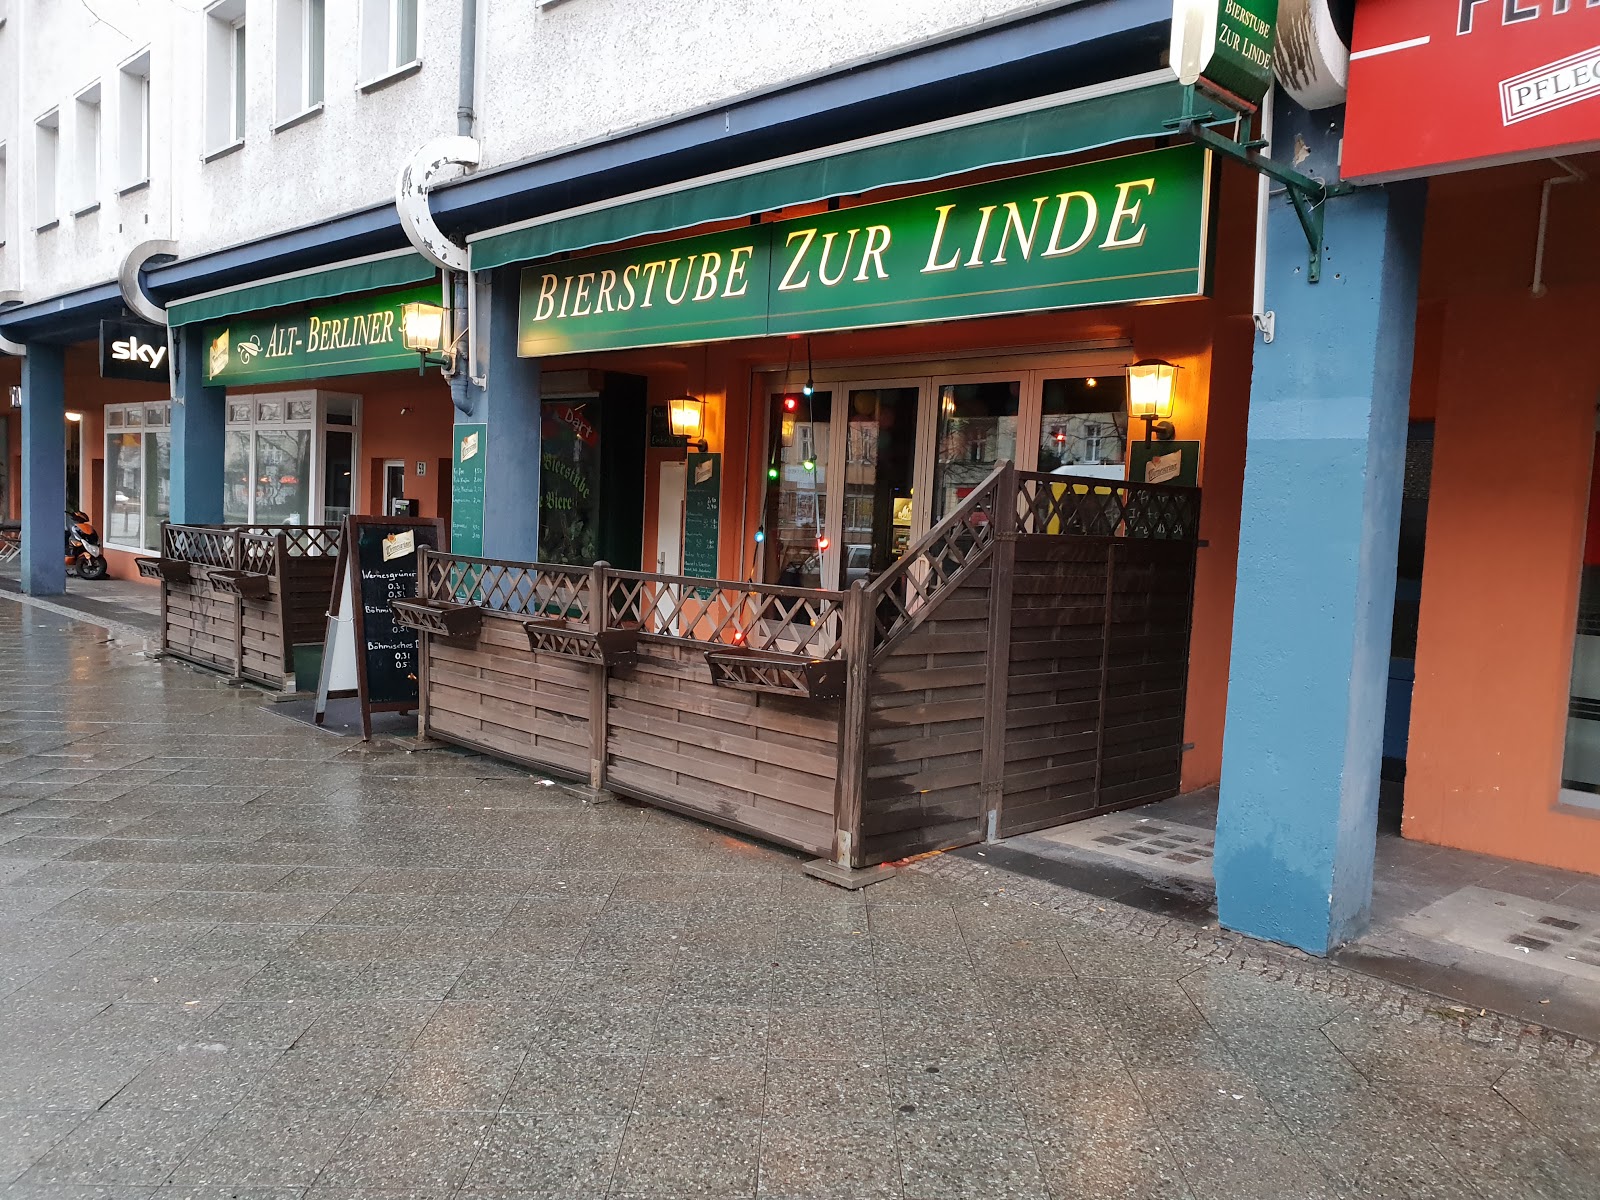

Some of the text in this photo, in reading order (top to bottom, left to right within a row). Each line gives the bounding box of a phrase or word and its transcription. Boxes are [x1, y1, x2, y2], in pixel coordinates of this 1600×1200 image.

[1225, 0, 1271, 39] BIERSTUBE
[1219, 23, 1271, 70] ZUR LINDE
[532, 177, 1156, 322] BIERSTUBE ZUR LINDE
[265, 310, 394, 358] ALT- BERLINER
[112, 336, 167, 369] sky
[565, 408, 593, 438] Dart
[546, 490, 572, 510] Biere
[365, 605, 393, 613] Böhmis
